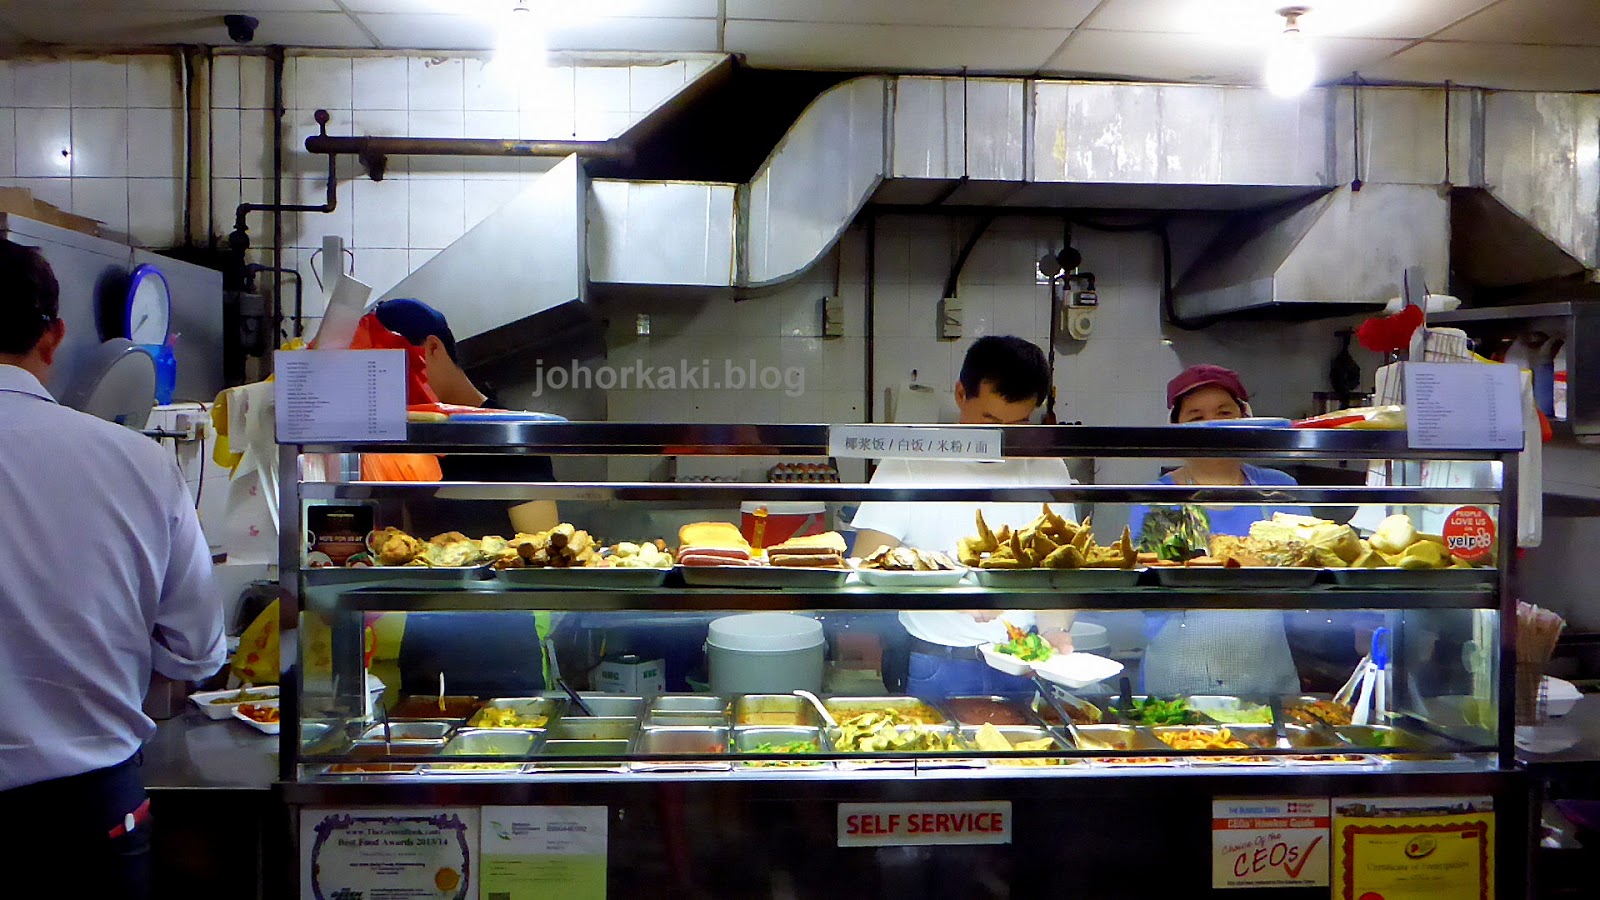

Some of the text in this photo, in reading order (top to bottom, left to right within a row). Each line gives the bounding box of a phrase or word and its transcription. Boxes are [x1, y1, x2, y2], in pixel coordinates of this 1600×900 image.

[845, 437, 885, 451] 椰浆饭
[898, 438, 924, 452] 白饭
[937, 440, 963, 453] 米粉
[1475, 518, 1486, 526] US
[1448, 534, 1476, 549] yelp
[847, 813, 1003, 834] SELF SERVICE
[338, 838, 355, 847] Best
[358, 838, 379, 846] Food
[384, 838, 413, 846] Awards
[1234, 842, 1298, 877] CEOs
